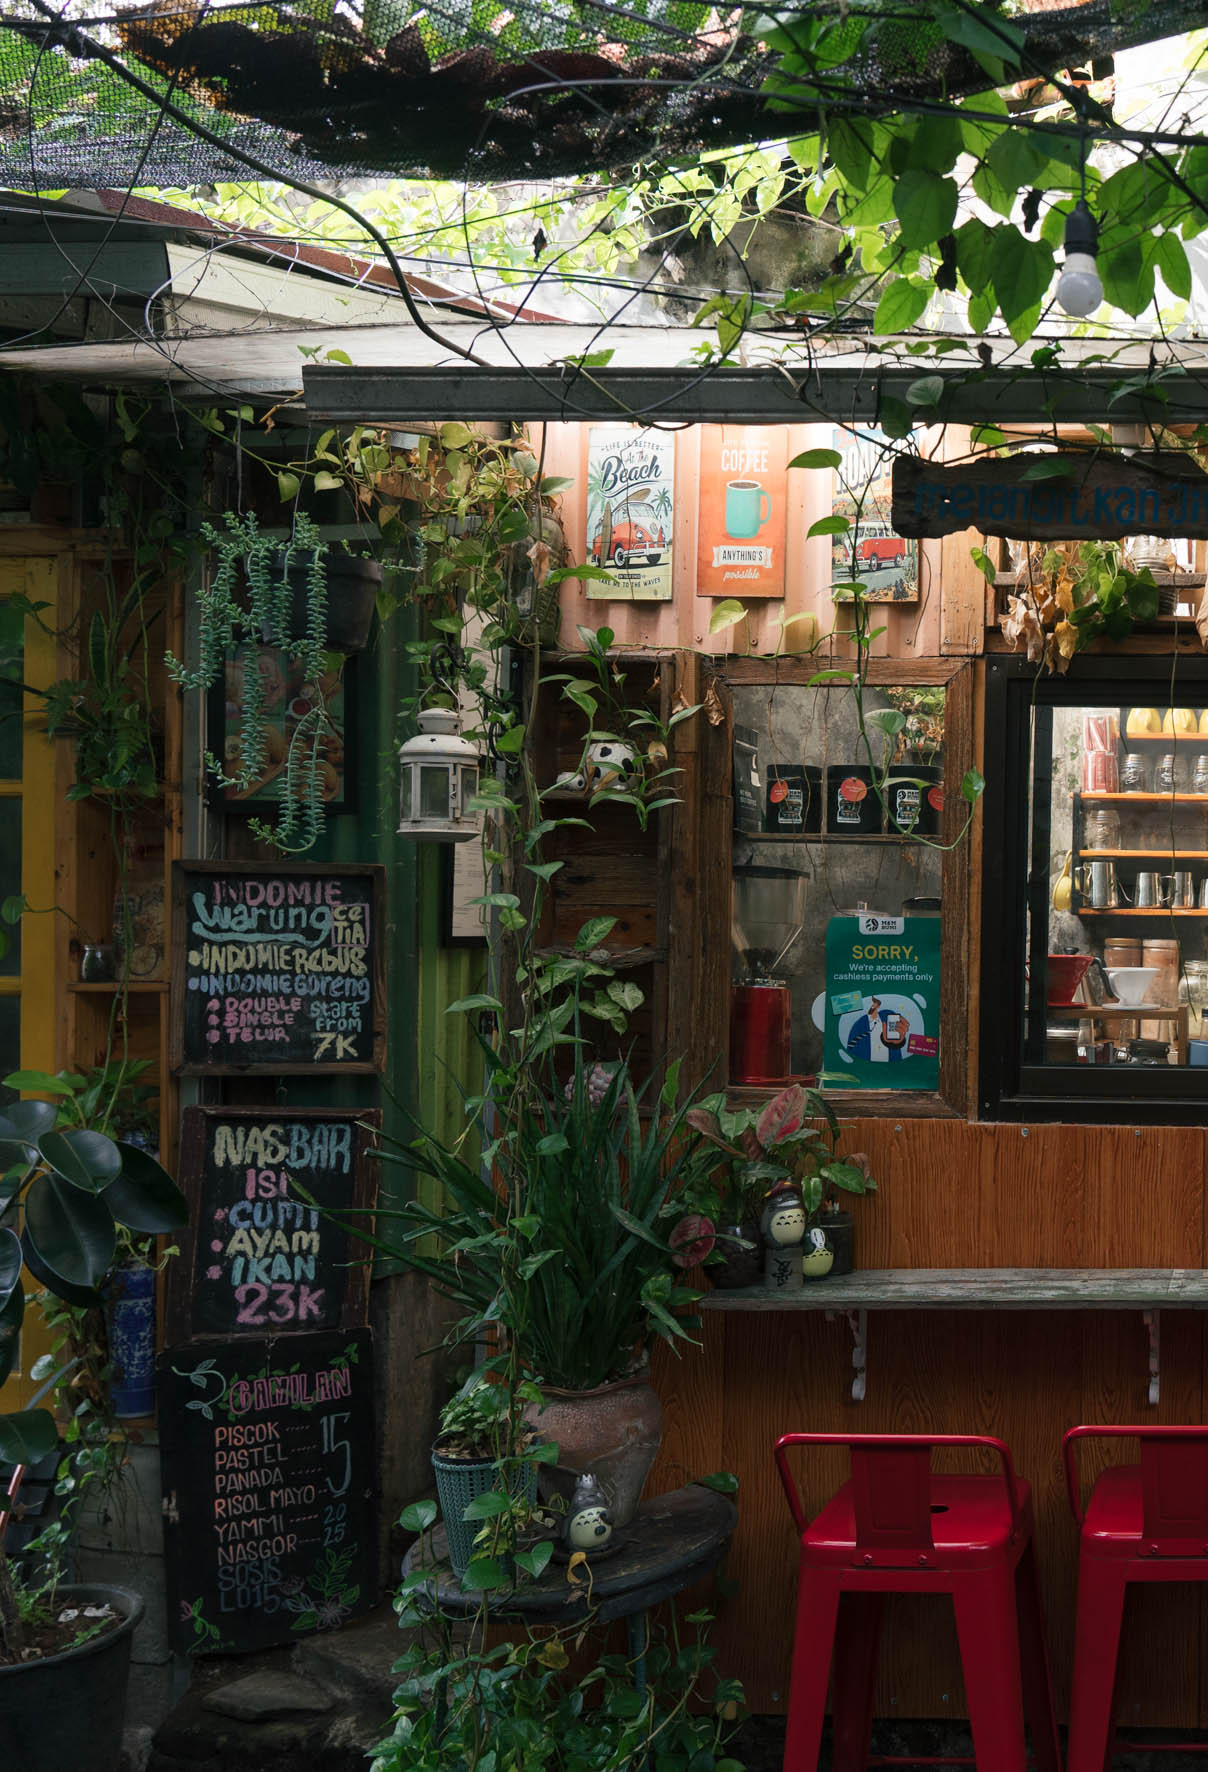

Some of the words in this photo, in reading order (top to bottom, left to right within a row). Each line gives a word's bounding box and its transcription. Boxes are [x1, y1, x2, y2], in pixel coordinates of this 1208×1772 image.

[635, 441, 660, 450] BETTER
[601, 455, 662, 491] Beach
[721, 449, 768, 472] COFFEE
[722, 550, 763, 561] ANYTHING'S
[643, 577, 661, 586] WAVES
[213, 881, 343, 906] INDOMIE
[202, 943, 293, 973] INDOMIE
[852, 945, 919, 962] SORRY,
[834, 972, 871, 981] cashless
[873, 973, 913, 982] payments
[915, 973, 933, 982] only
[876, 964, 917, 973] accepting
[225, 997, 302, 1013] DOUBLE
[223, 1012, 295, 1027] SINGLE
[311, 1032, 358, 1060] 7K
[229, 1200, 319, 1229] CUMI
[226, 1228, 320, 1259] AYAM
[231, 1253, 316, 1286] IKAN
[234, 1282, 325, 1324] 23K
[229, 1368, 352, 1414] CAMILAN
[215, 1422, 280, 1448] PISCOK
[320, 1411, 352, 1498] 15
[215, 1444, 288, 1471] PASTEL
[215, 1467, 284, 1494] PANADA
[214, 1494, 267, 1520] RISOL
[270, 1484, 316, 1509] MAYO
[214, 1514, 284, 1544] YAMMI
[323, 1503, 348, 1526] 20
[217, 1534, 297, 1566] NASGOR
[323, 1522, 347, 1547] 25
